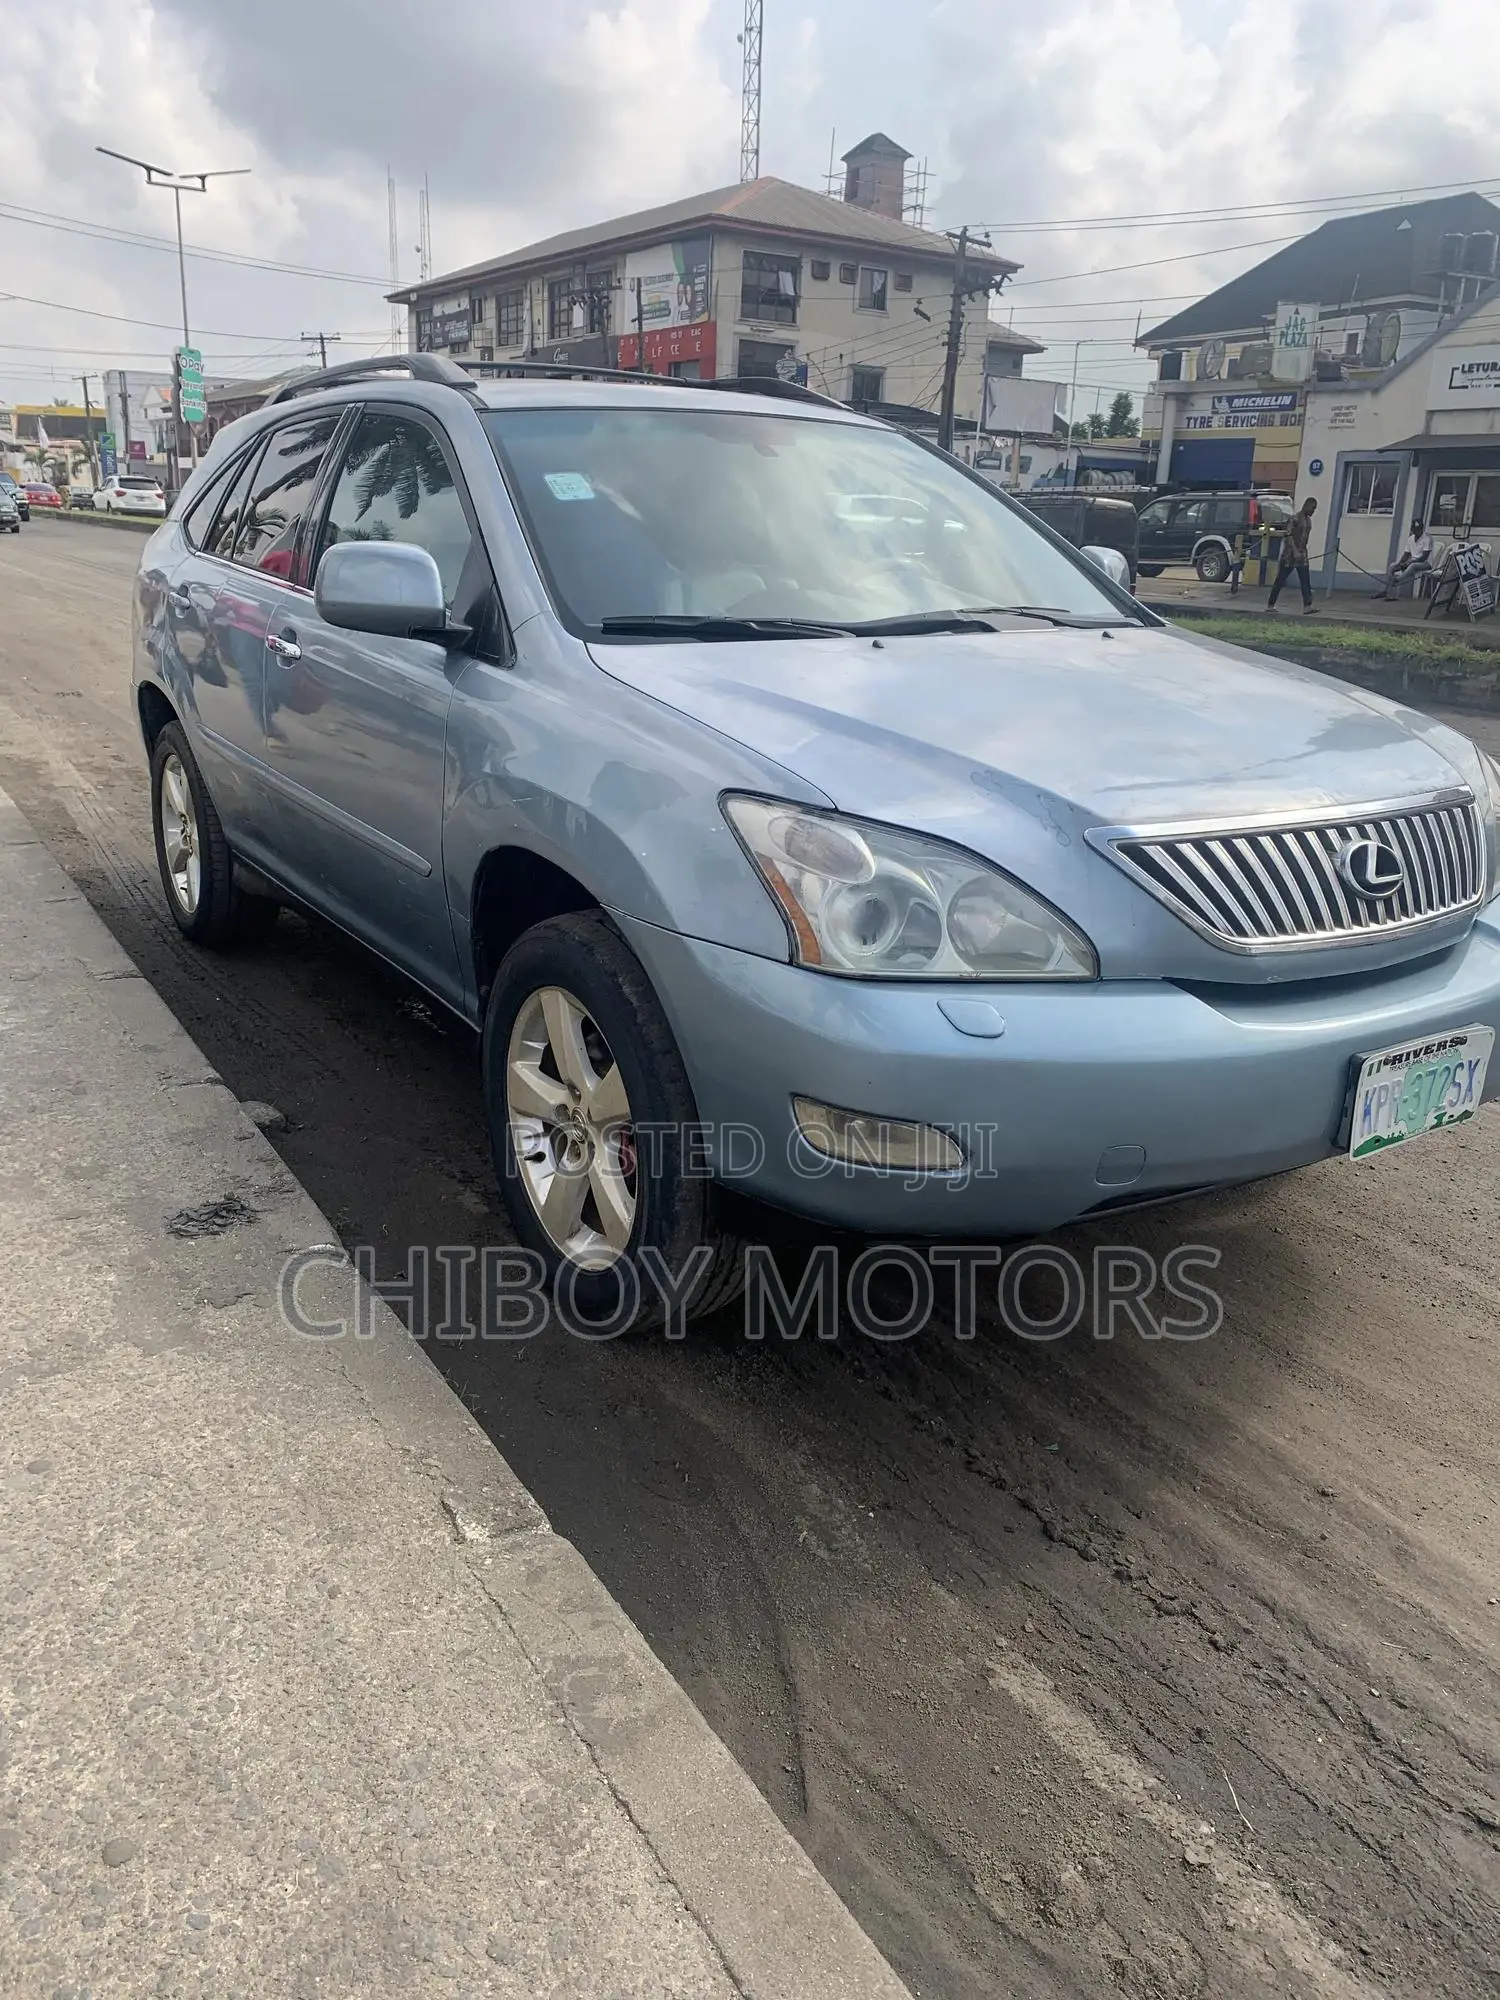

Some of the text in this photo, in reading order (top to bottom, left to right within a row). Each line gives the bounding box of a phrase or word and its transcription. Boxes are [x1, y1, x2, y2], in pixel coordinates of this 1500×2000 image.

[1285, 315, 1306, 331] JAC
[1279, 331, 1307, 347] PLAZA
[180, 356, 205, 373] OPay
[1461, 361, 1500, 374] LETUR
[1232, 396, 1292, 407] MICHELIN
[1186, 416, 1213, 428] TYRE
[1217, 414, 1276, 427] SERVICING
[1456, 548, 1484, 575] POS
[1390, 1037, 1462, 1066] RIVERS
